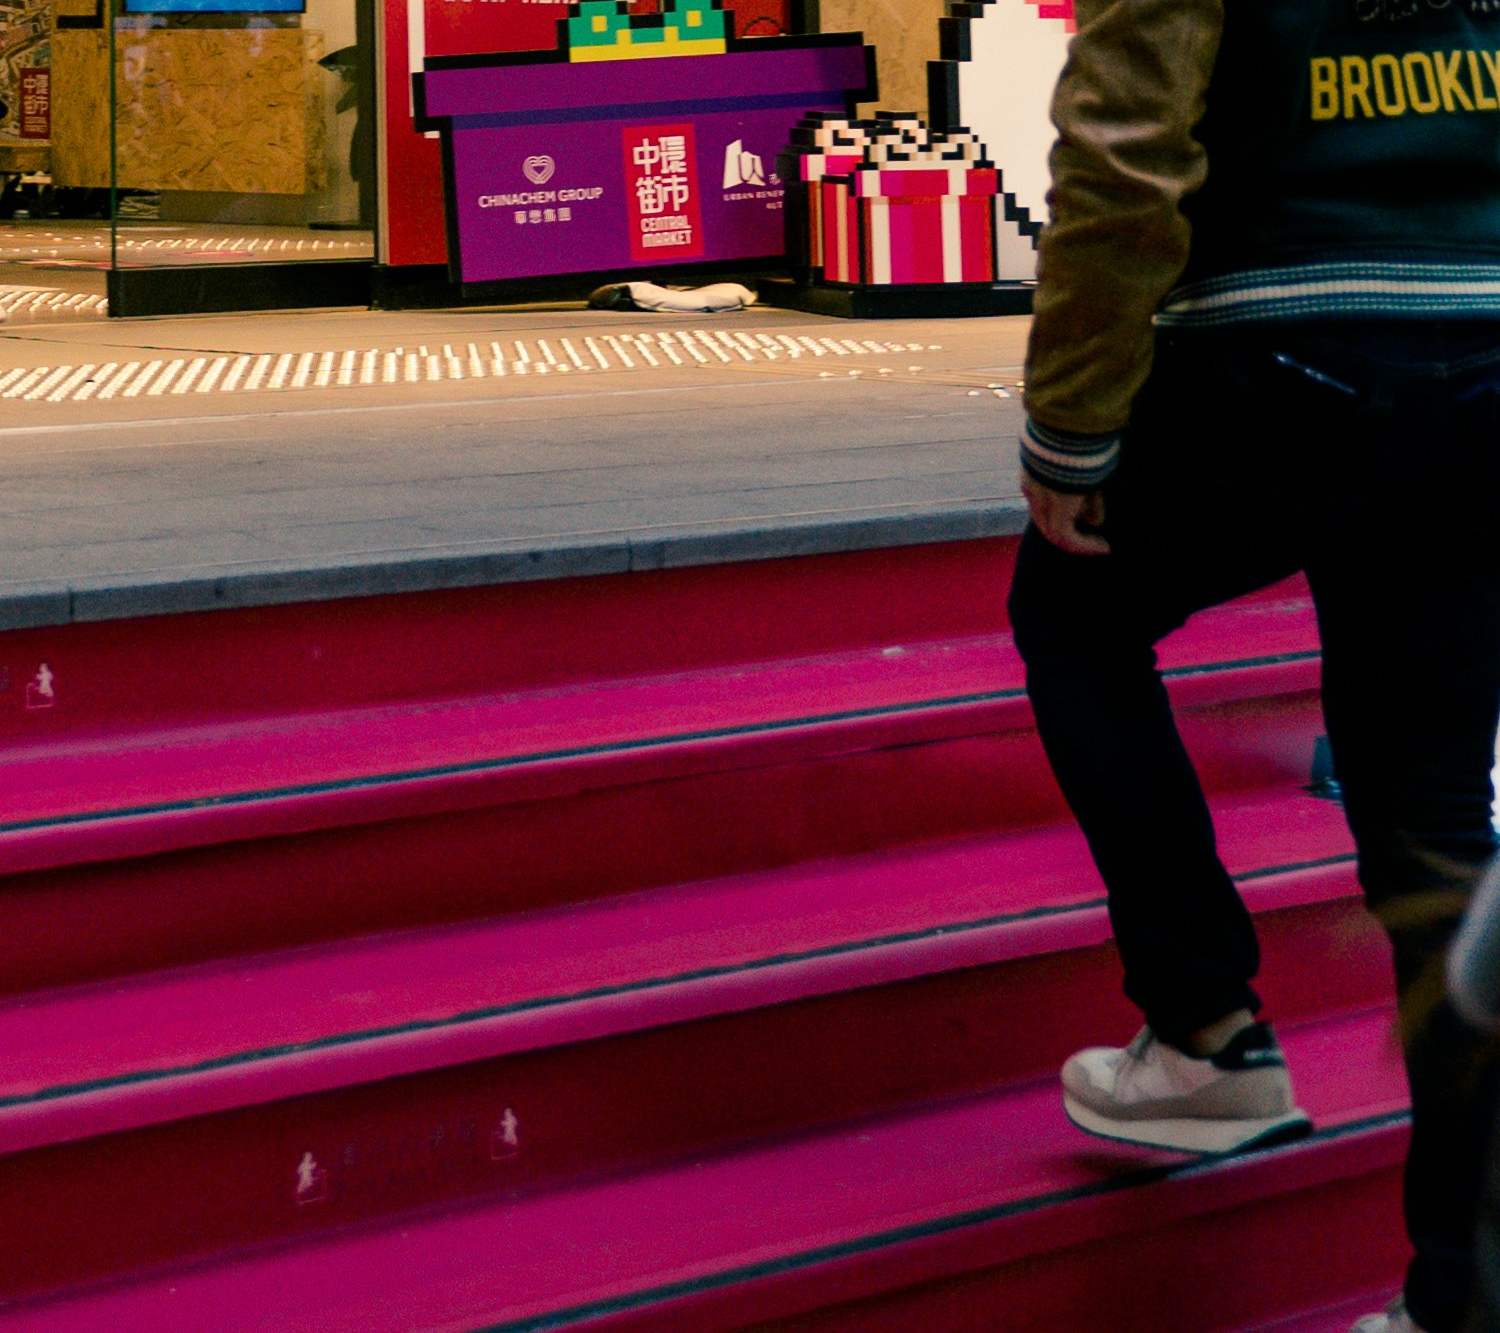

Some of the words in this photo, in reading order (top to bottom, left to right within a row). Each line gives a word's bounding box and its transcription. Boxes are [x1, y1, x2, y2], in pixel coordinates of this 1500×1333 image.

[478, 190, 556, 208] CHINACHEM
[558, 187, 603, 202] GROUP
[640, 215, 692, 233] CENTRAL
[641, 229, 693, 248] MARKET
